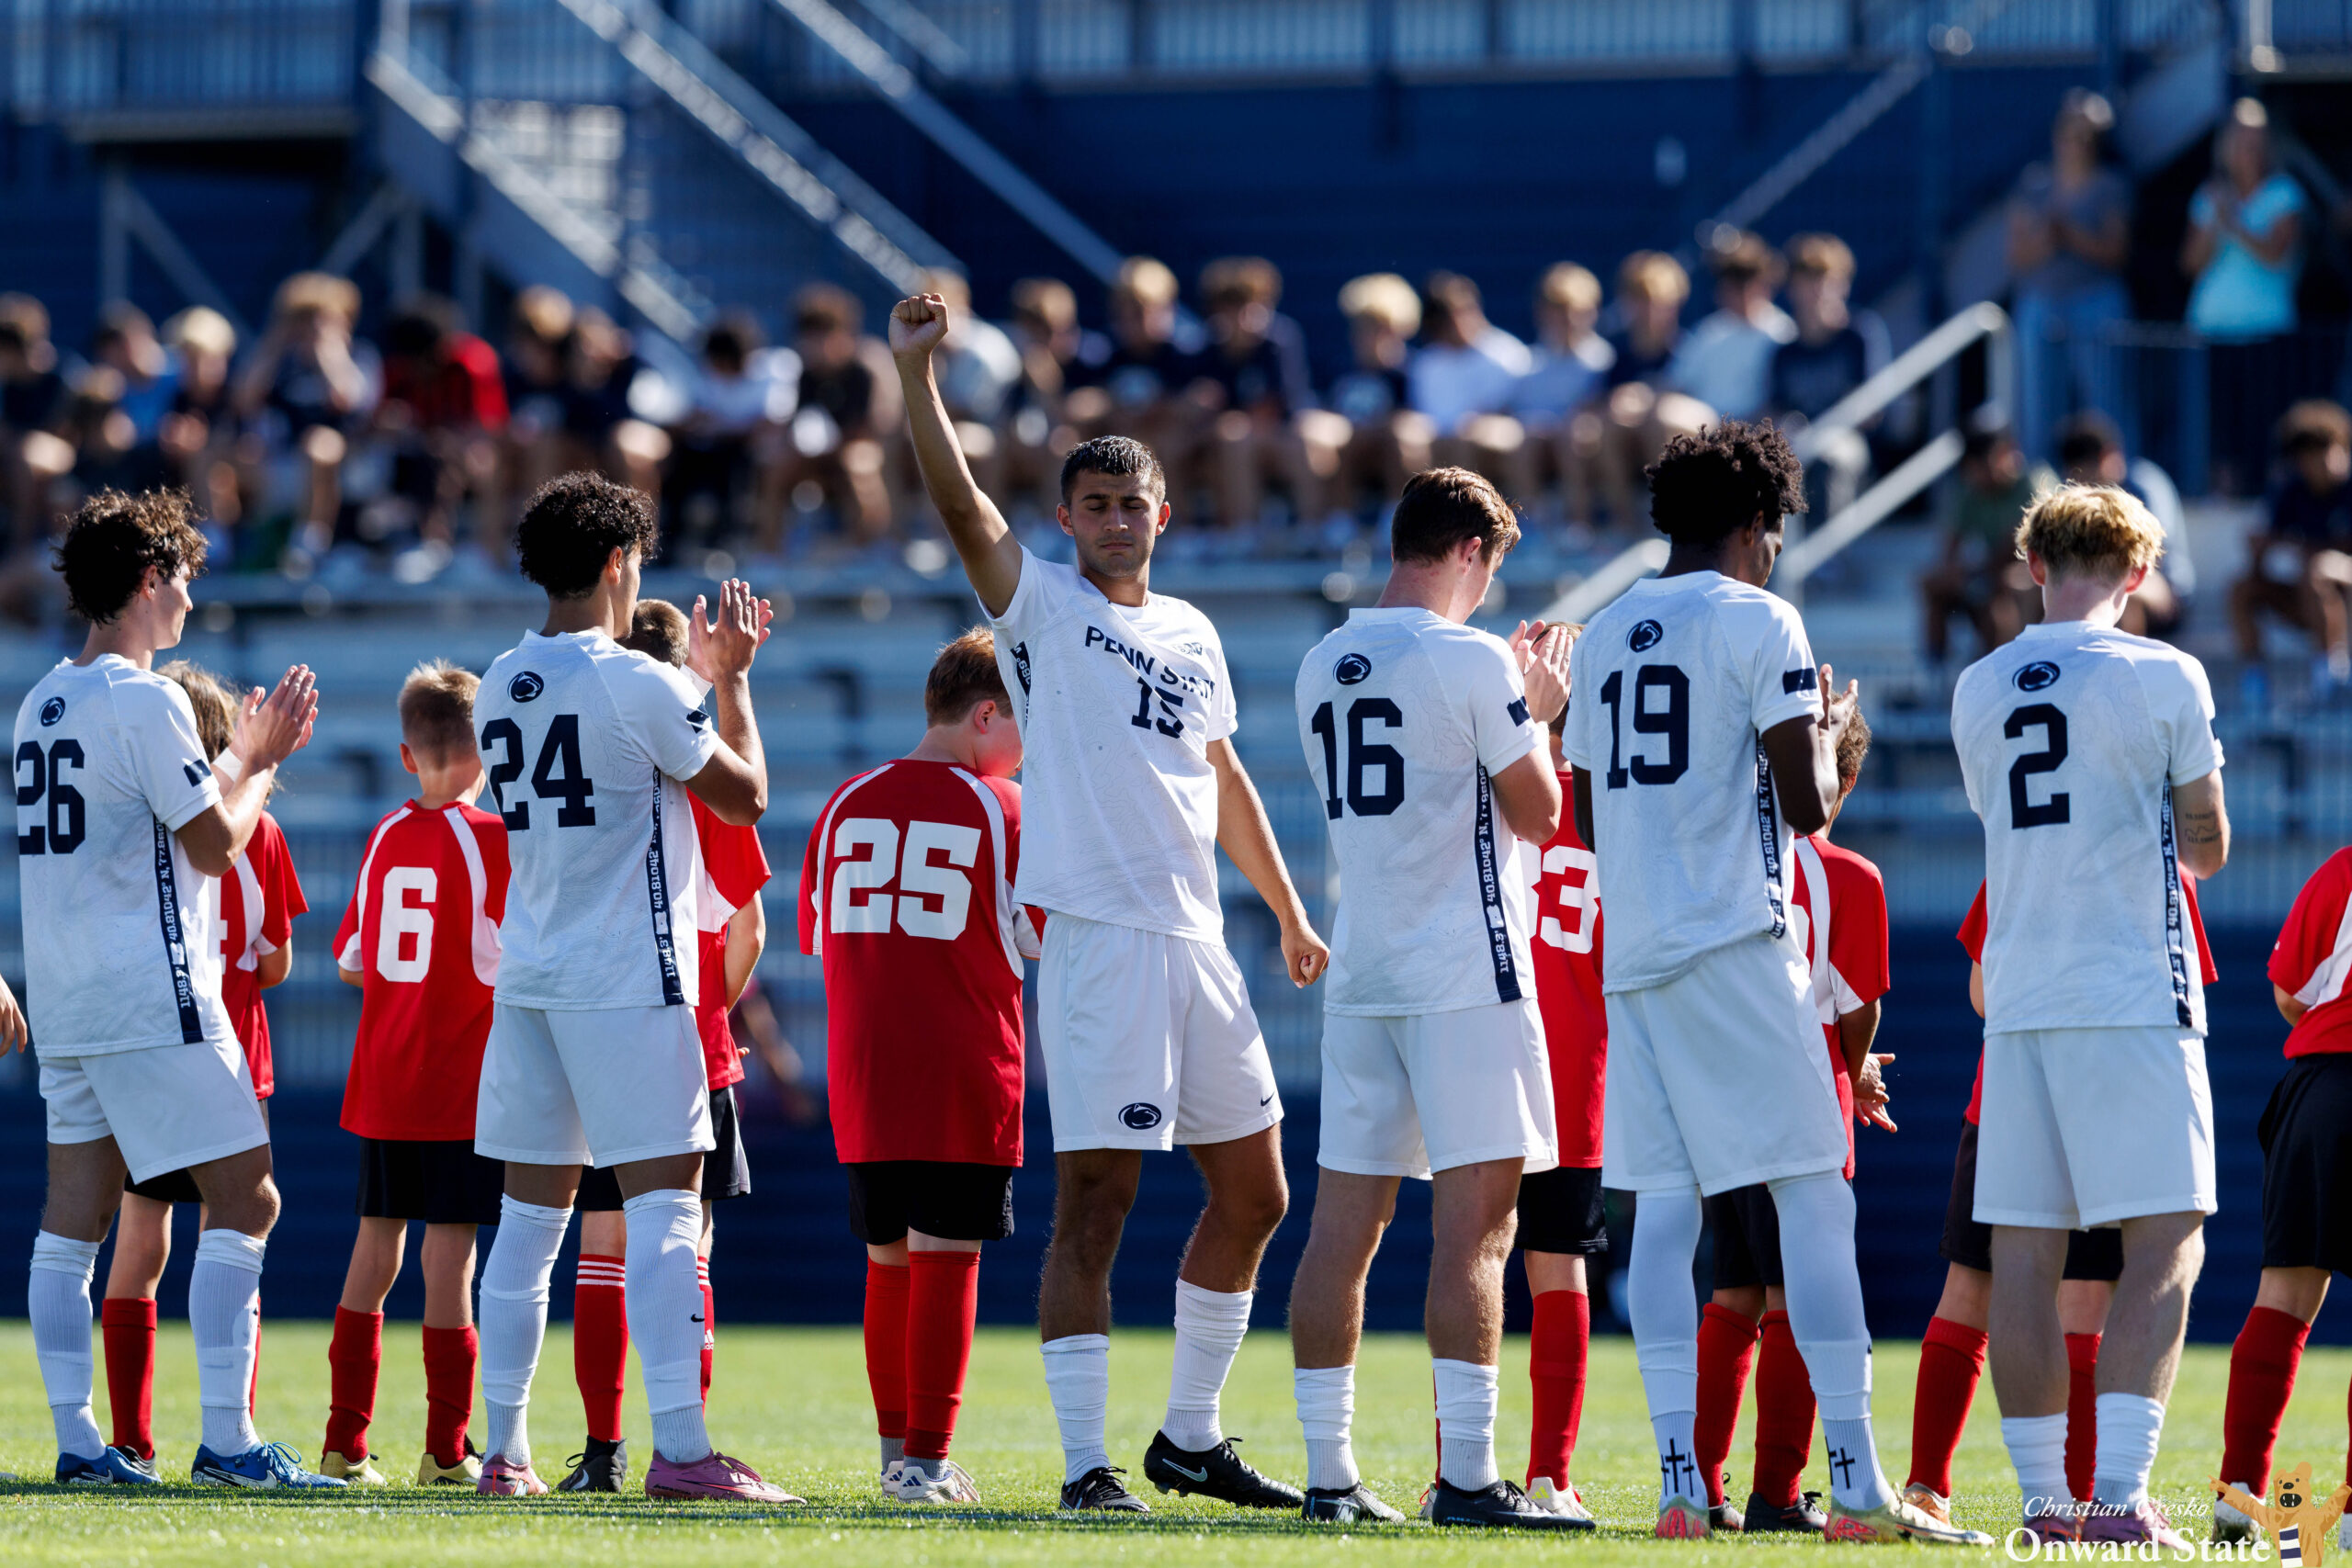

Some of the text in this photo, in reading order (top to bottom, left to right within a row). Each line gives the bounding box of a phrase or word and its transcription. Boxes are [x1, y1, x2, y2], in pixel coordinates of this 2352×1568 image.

[1085, 626, 1155, 675] PENN
[1131, 676, 1183, 739] 15
[481, 714, 596, 831] 24
[1311, 697, 1406, 820] 16
[1600, 664, 1690, 791] 19
[2003, 703, 2071, 829] 2
[16, 739, 85, 855] 26
[377, 866, 436, 983] 6
[831, 817, 982, 941] 25
